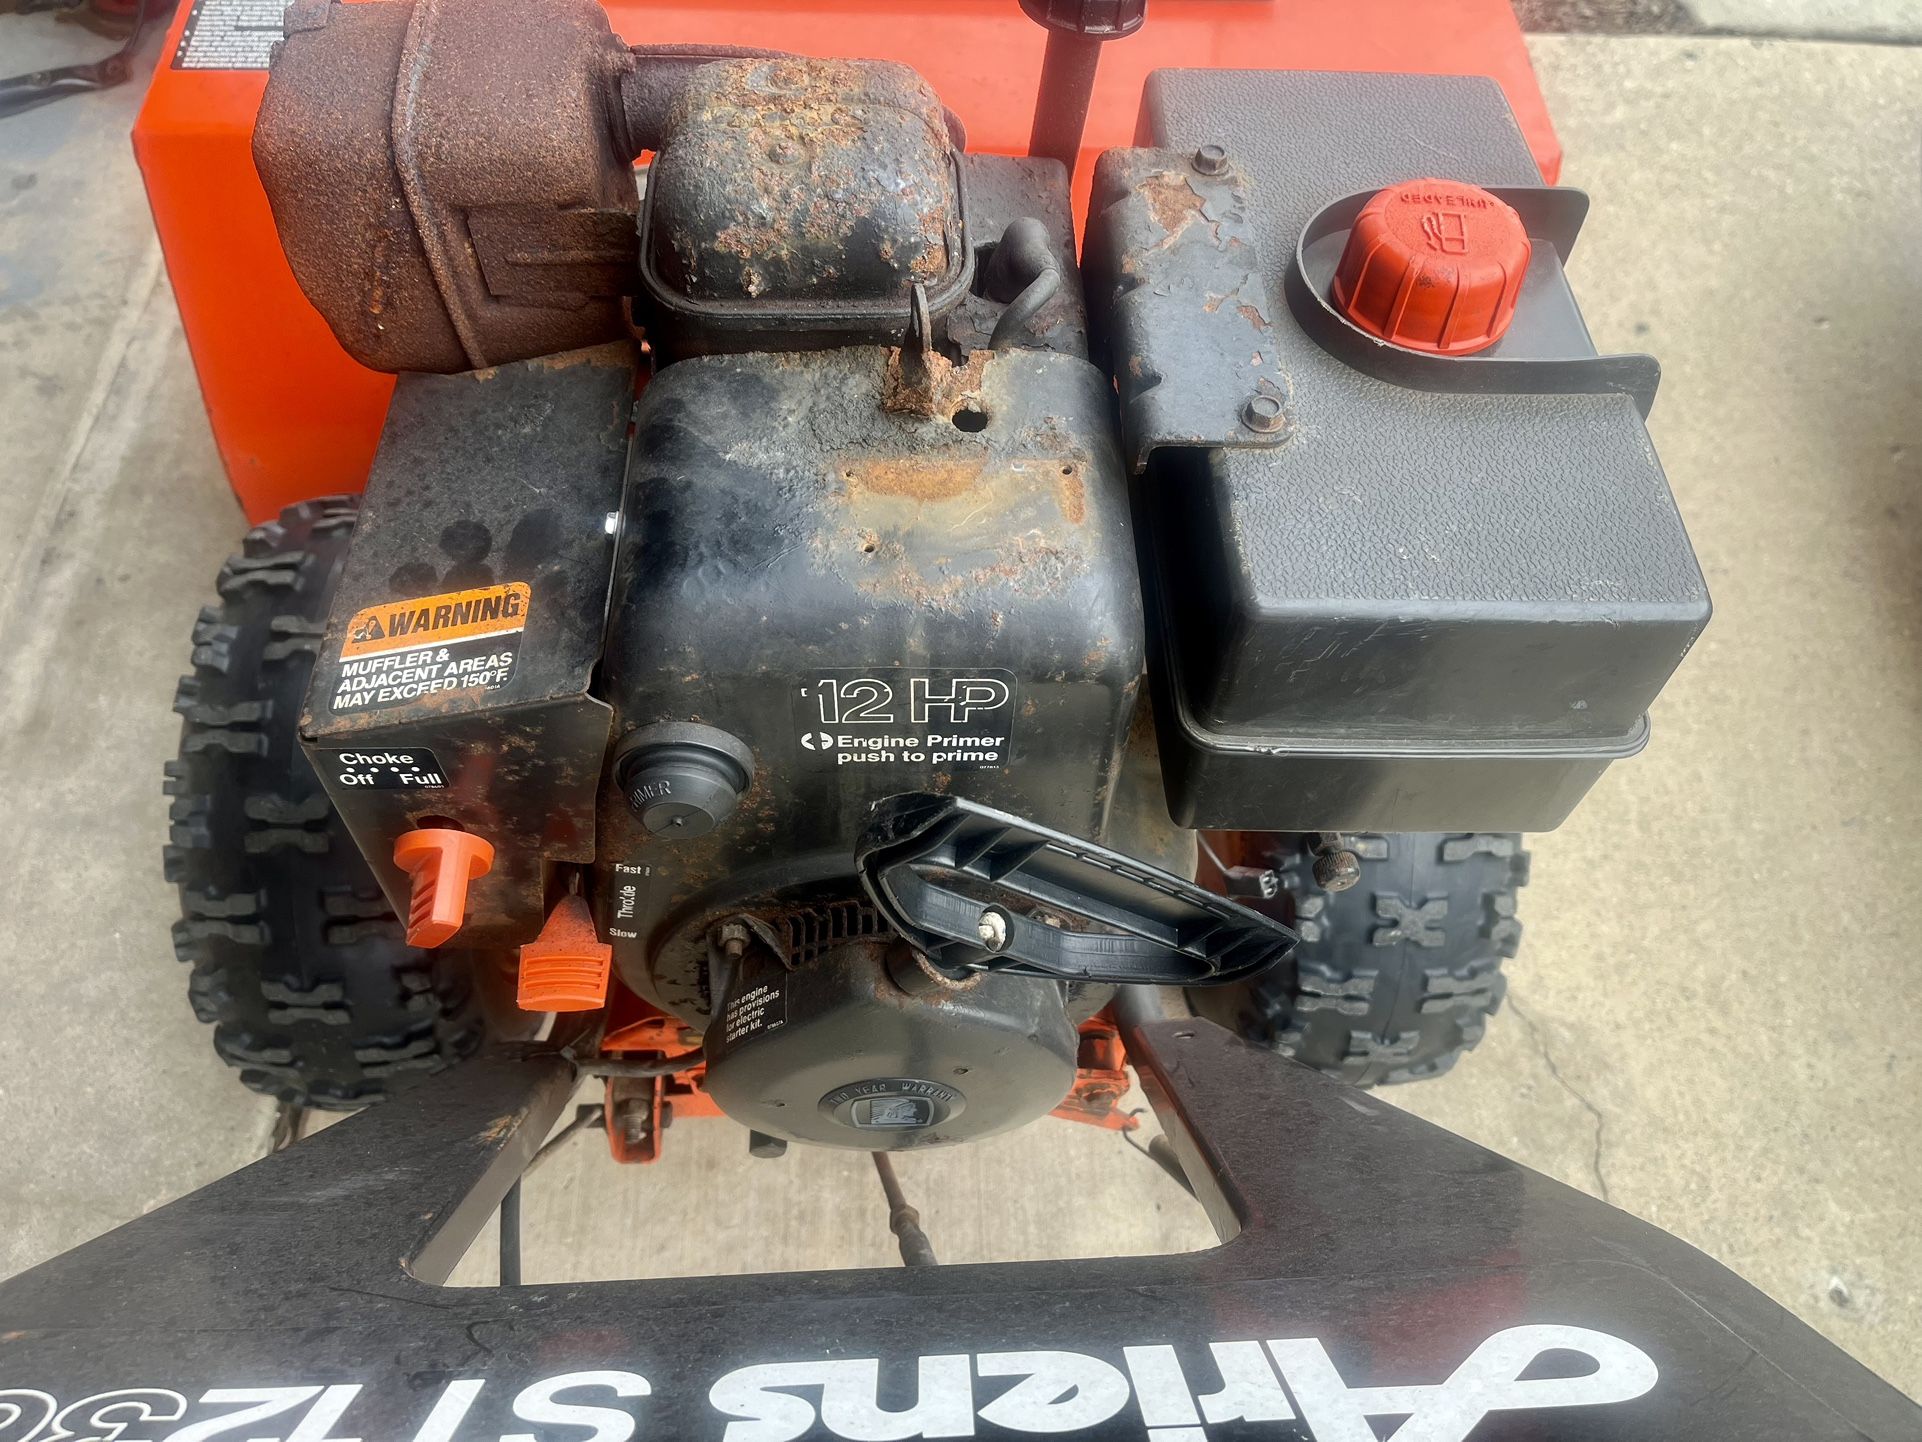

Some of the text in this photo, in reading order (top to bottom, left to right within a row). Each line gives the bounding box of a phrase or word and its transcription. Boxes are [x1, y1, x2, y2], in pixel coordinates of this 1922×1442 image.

[388, 592, 521, 638] WARNING
[337, 651, 513, 694] ADJACENT AREAS
[341, 648, 450, 677] MUFFLER &
[333, 691, 373, 710] MAY
[377, 677, 458, 703] EXCEED
[817, 678, 1010, 723] 12 HP
[837, 735, 1005, 750] Engine Primer
[339, 753, 414, 766] Choke
[837, 750, 999, 764] push to prime
[339, 773, 442, 785] Off Full
[630, 780, 672, 812] RIMER
[615, 863, 642, 875] Fast
[609, 927, 637, 938] Slow
[741, 985, 768, 1003] engine
[726, 990, 780, 1022] has provisions
[736, 1007, 765, 1027] electric
[726, 1025, 749, 1044] starter
[750, 1019, 763, 1030] kit.
[854, 1083, 887, 1096] YEAR
[900, 1082, 955, 1103] WARRANT
[708, 1323, 1660, 1442] Ariens
